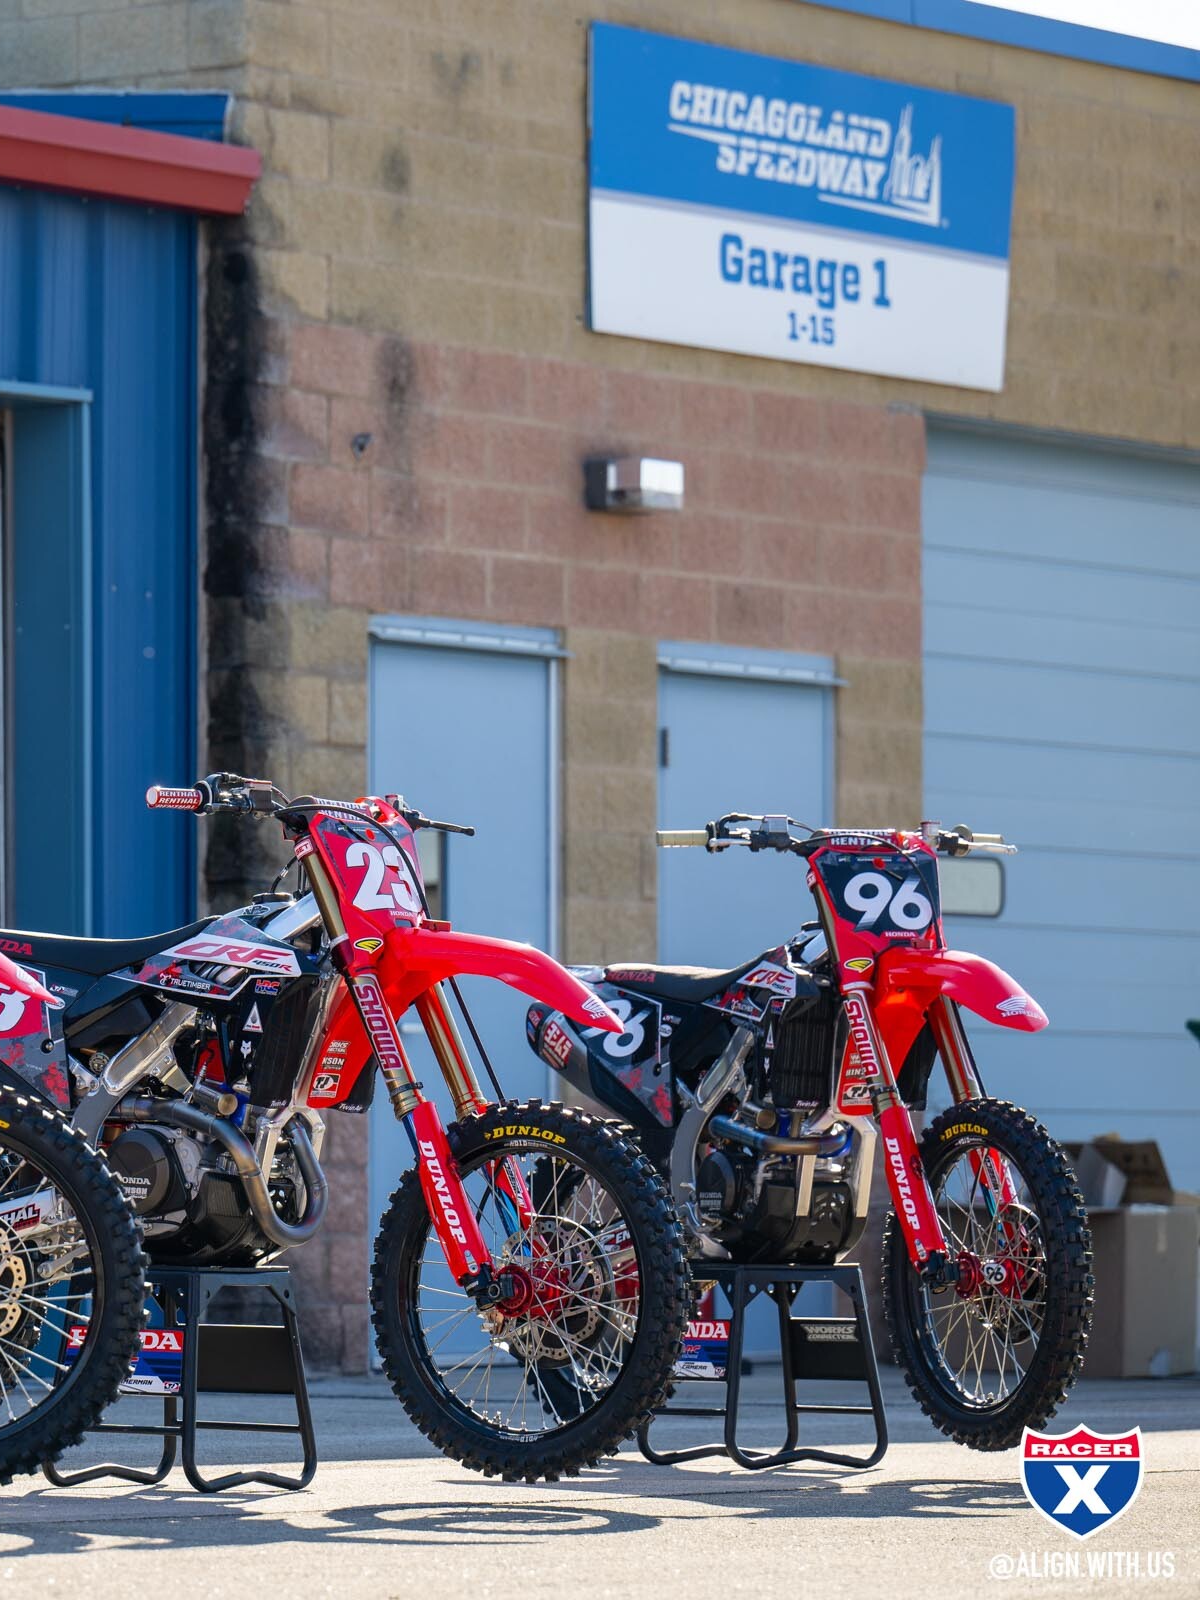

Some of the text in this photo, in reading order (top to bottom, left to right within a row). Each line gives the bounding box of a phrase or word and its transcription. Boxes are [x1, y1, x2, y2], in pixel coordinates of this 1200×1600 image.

[668, 80, 892, 156] CHICAGOLAND
[716, 142, 887, 198] SPEEDWAY
[719, 233, 892, 310] Garage 1
[787, 312, 836, 347] 1-15
[345, 842, 424, 913] 23
[843, 871, 933, 931] 96
[174, 942, 293, 963] CRF
[169, 977, 211, 990] TRUETIMBER
[255, 979, 281, 993] HRC
[606, 970, 657, 983] HONDA
[354, 984, 402, 1070] SHOWA
[843, 1000, 880, 1077] SHOWA
[321, 1058, 345, 1066] NSON
[492, 1125, 567, 1144] DUNLOP
[944, 1123, 989, 1140] DUNLOP
[122, 1176, 151, 1185] ONDA
[418, 1140, 467, 1244] DUNLOP
[885, 1137, 920, 1230] DUNLOP
[685, 1322, 729, 1338] NDA
